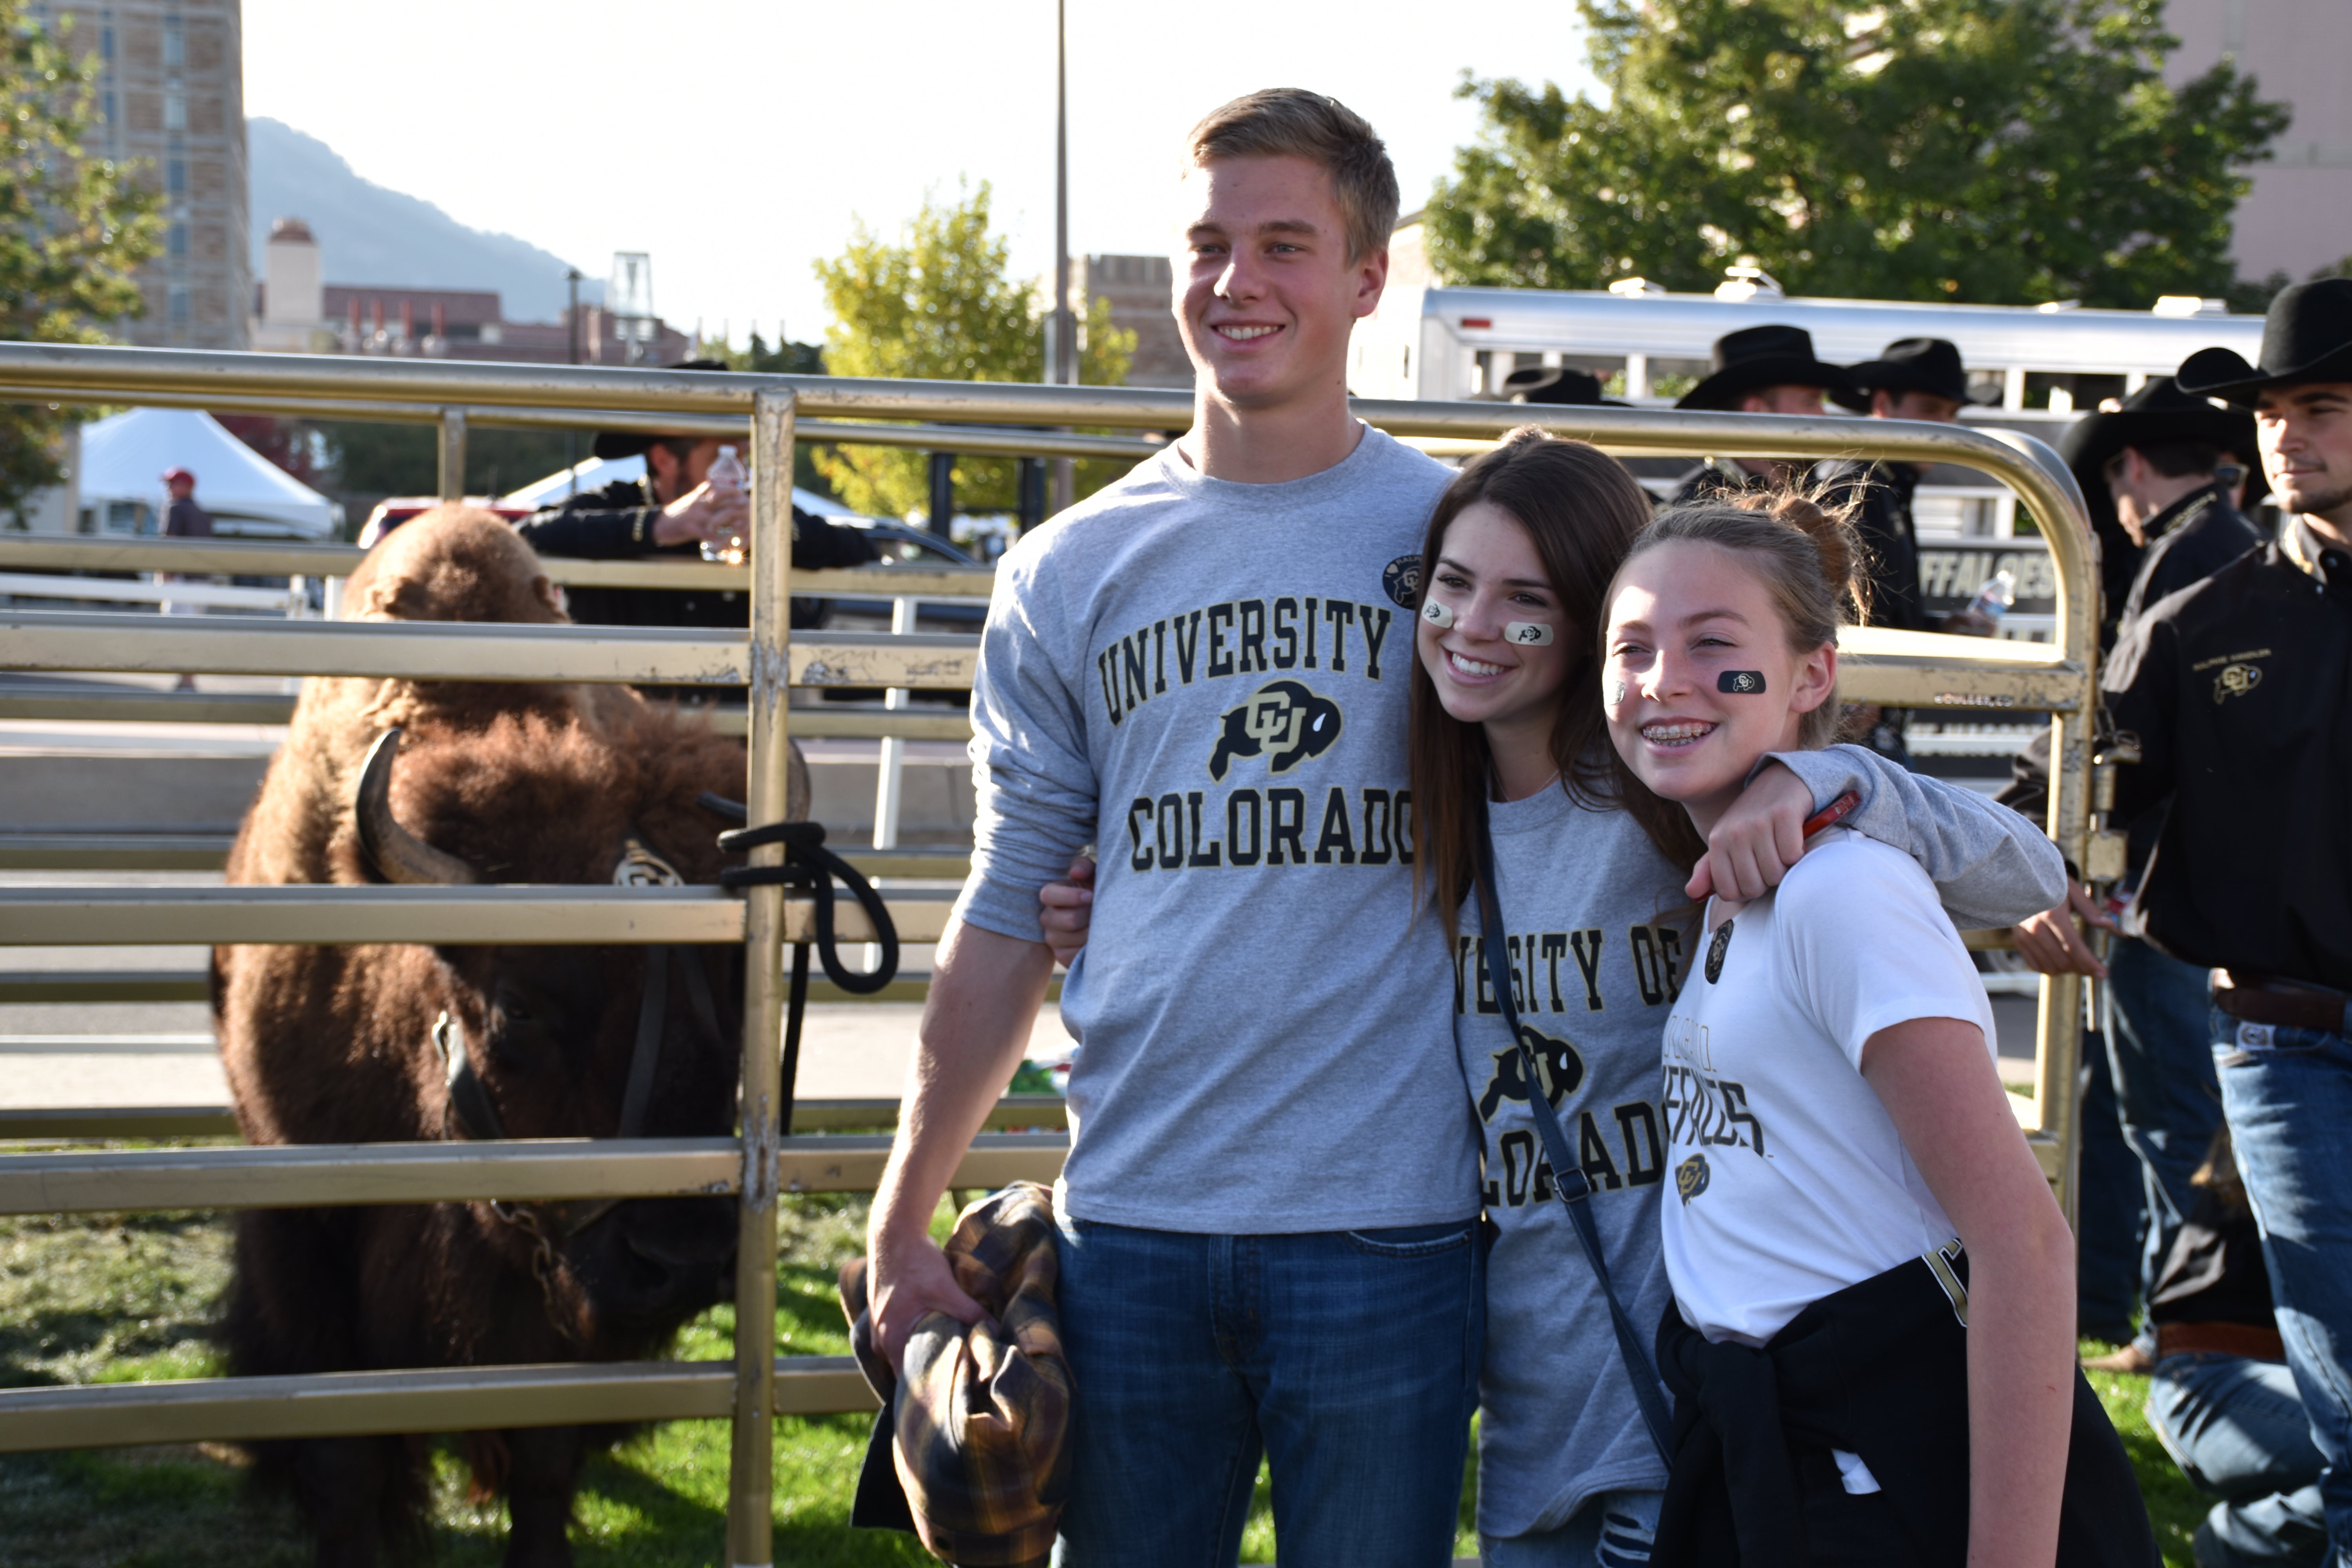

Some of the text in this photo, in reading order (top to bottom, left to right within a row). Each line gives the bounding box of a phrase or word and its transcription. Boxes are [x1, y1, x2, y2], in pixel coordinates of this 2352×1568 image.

[1098, 597, 1391, 727] UNIVERSITY
[1244, 691, 1307, 753] CU
[1128, 787, 1414, 871] COLORADO
[1629, 924, 1682, 1006] OF
